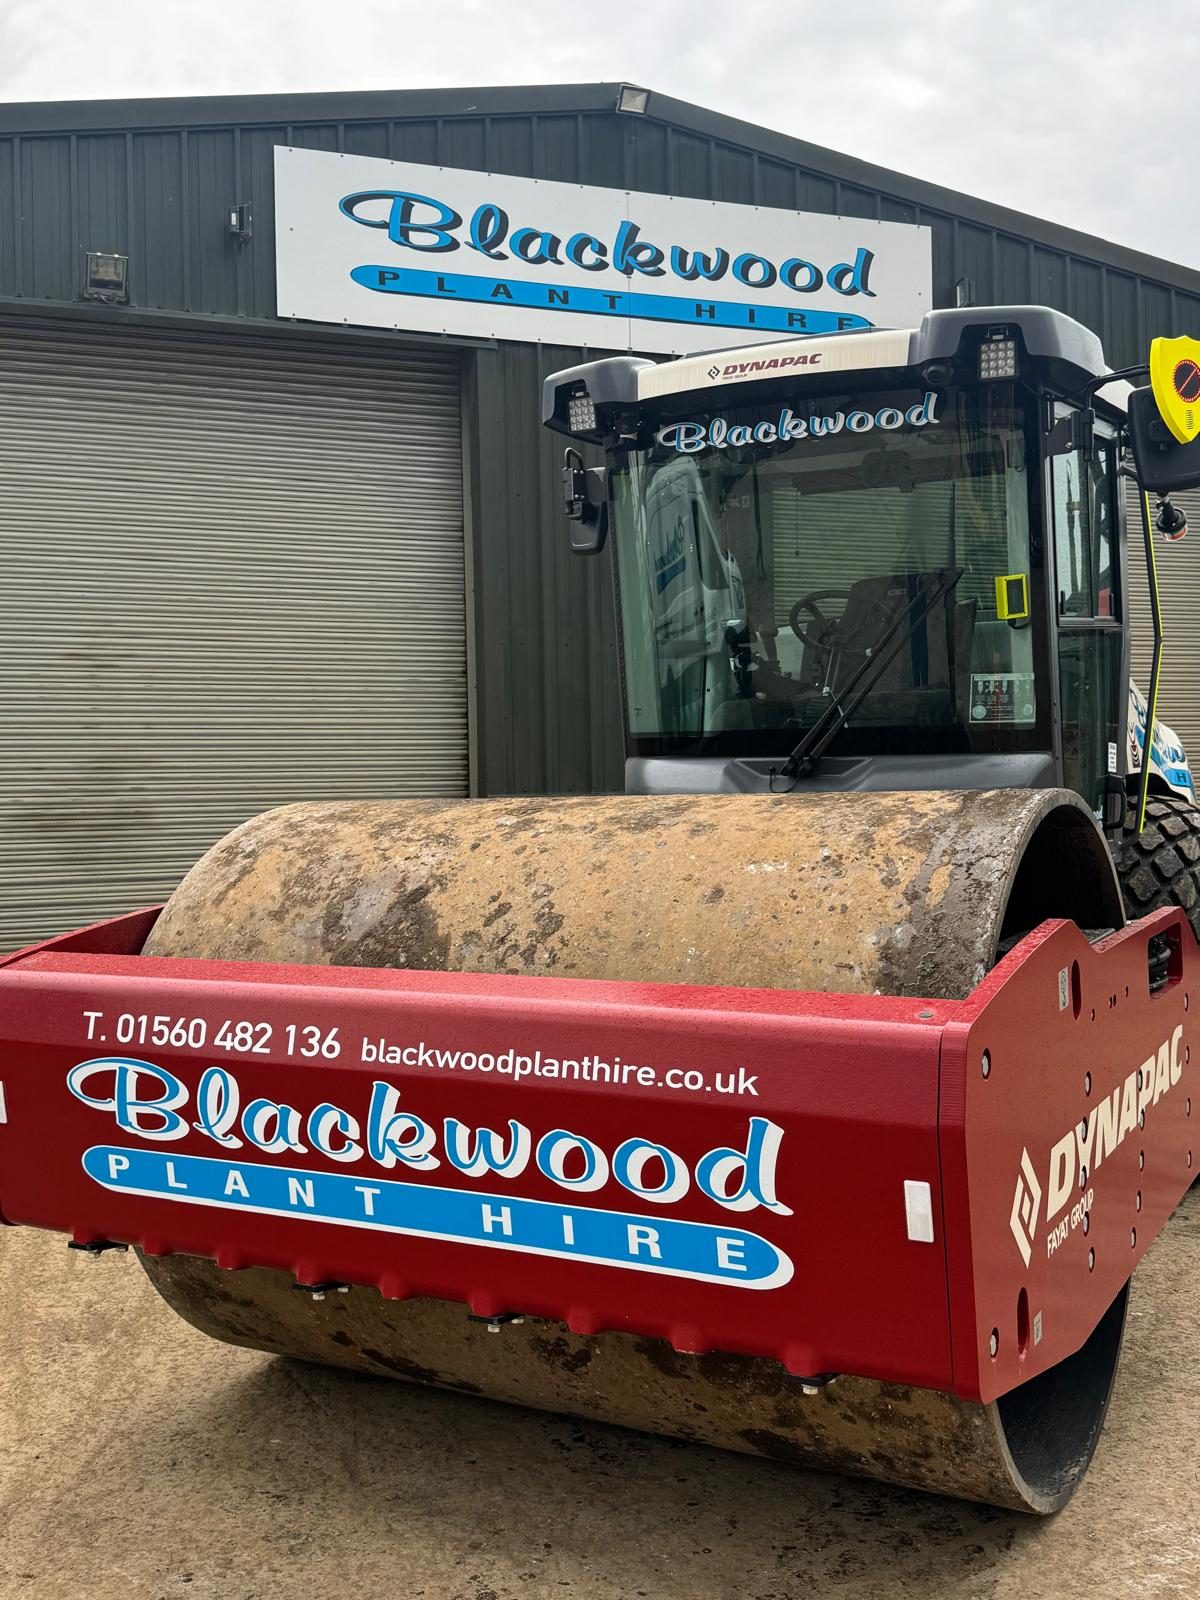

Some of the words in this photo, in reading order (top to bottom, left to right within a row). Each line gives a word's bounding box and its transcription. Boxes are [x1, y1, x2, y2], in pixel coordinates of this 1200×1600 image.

[339, 190, 877, 297] Blackwood
[378, 270, 622, 310] PLANT
[696, 303, 853, 331] HIRE
[723, 353, 822, 376] DYNAPAC
[657, 391, 940, 453] Blackwood
[83, 1011, 106, 1042] T.
[116, 1013, 207, 1049] 01560
[213, 1020, 273, 1054] 482
[285, 1024, 341, 1059] 136
[360, 1036, 759, 1096] blackwoodplanthire.co.uk
[66, 1056, 794, 1215] Blackwood
[1047, 1024, 1183, 1222] DYNAPAC
[107, 1153, 381, 1216] PLANT
[481, 1203, 748, 1272] HIRE
[1047, 1213, 1070, 1259] FAYAT
[1070, 1188, 1094, 1230] GROUP
